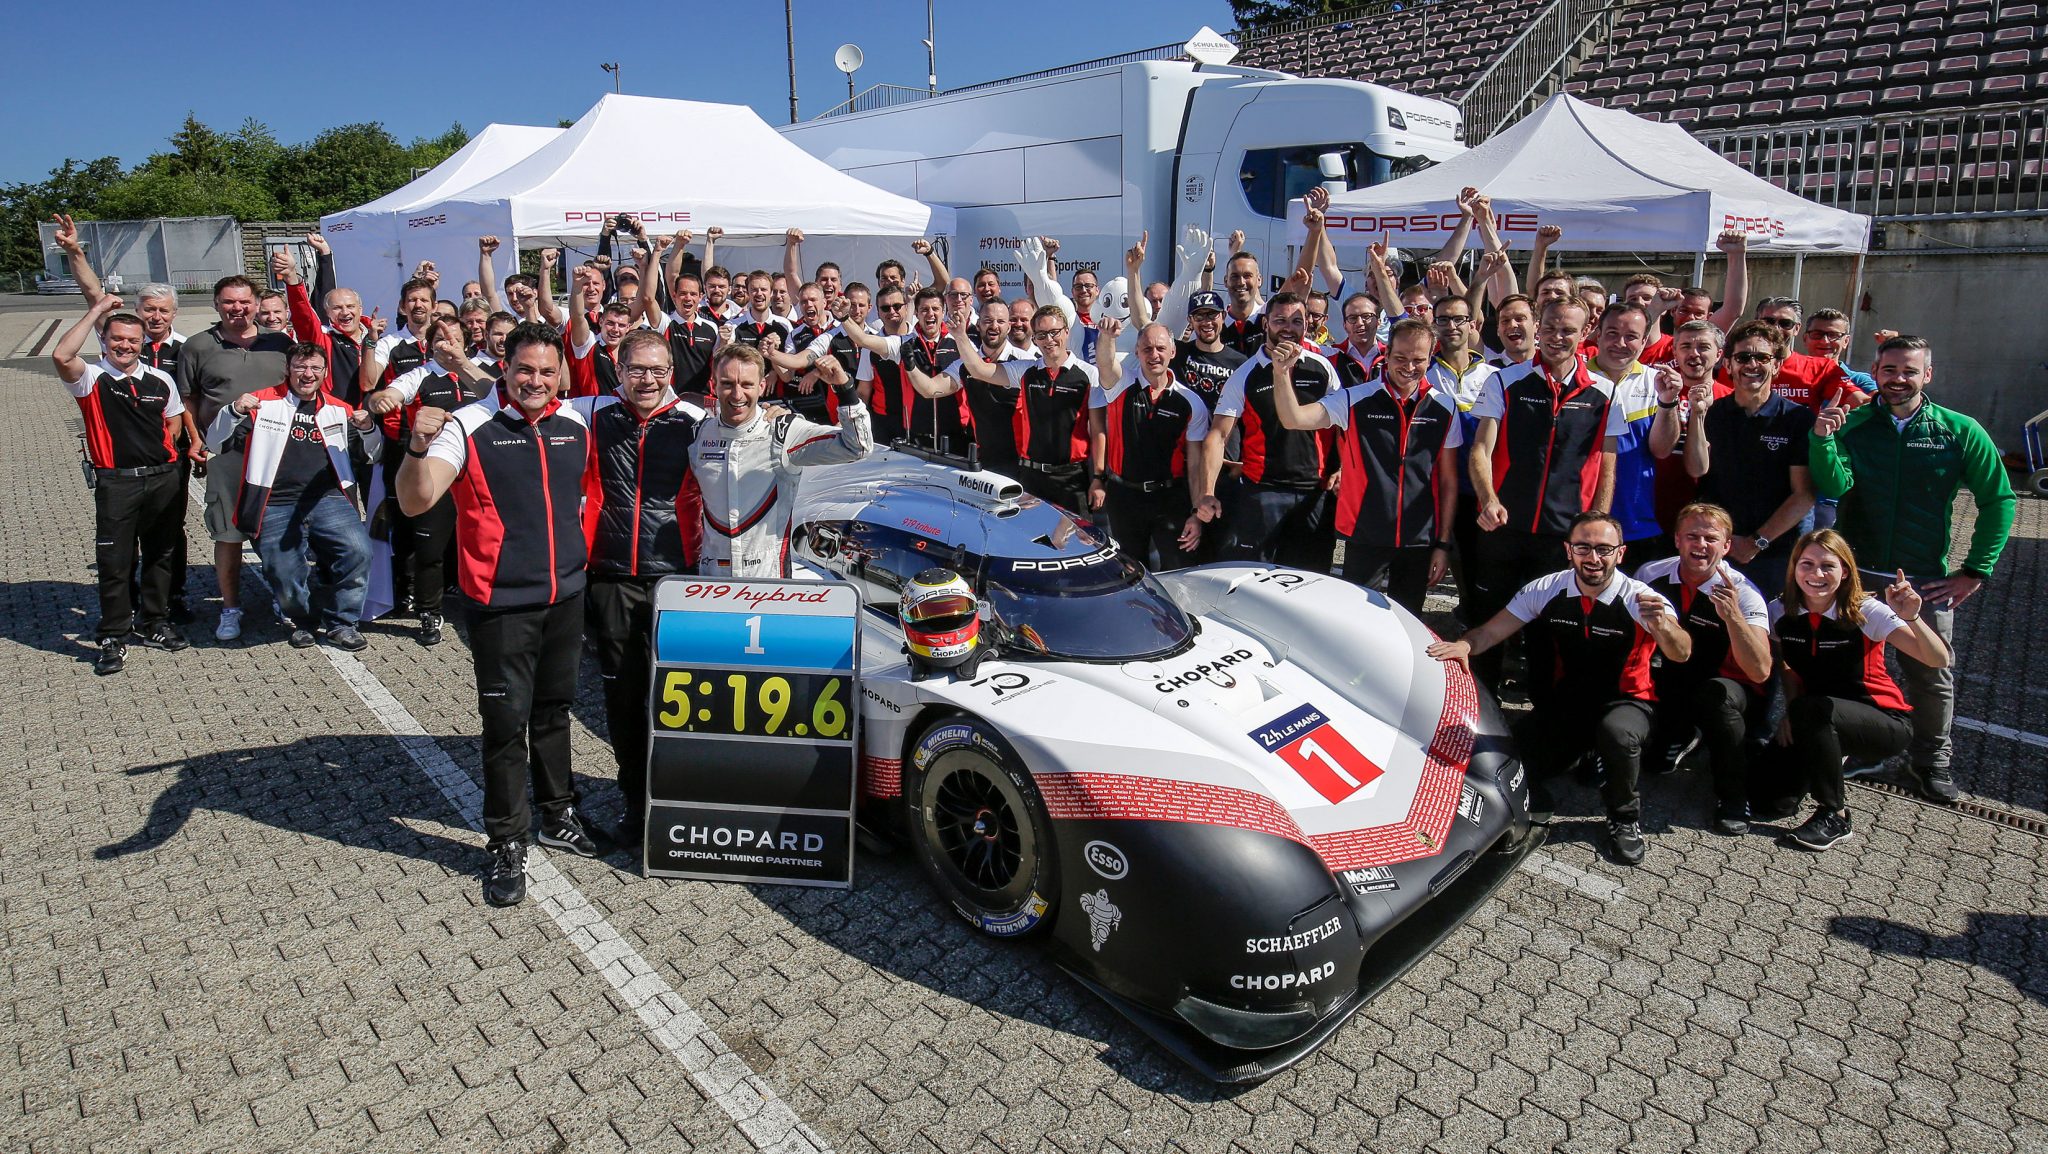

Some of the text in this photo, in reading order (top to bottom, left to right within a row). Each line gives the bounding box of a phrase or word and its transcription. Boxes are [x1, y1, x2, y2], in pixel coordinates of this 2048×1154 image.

[1406, 111, 1453, 129] PORSCHE
[327, 222, 353, 232] PORSCHE
[408, 214, 447, 229] PORSCHE
[1724, 214, 1785, 237] PORSCHE
[980, 260, 1017, 273] Mission:
[1193, 293, 1214, 306] YZ
[1772, 388, 1809, 398] RIBUTE
[702, 439, 719, 447] Mobil
[958, 474, 984, 492] Mobil
[902, 517, 942, 535] 919 tribute
[743, 558, 762, 567] Timo
[1012, 536, 1121, 572] PORSCHE
[685, 584, 831, 610] 919 hybrid
[744, 615, 765, 655] 1
[931, 646, 968, 658] CHOPARD
[1155, 649, 1253, 693] CHOPARD
[861, 685, 901, 714] HOPARD
[991, 679, 1057, 706] PORSCHE
[1260, 712, 1321, 747] 24h LE MANS
[928, 729, 969, 749] MICHELIN
[1298, 737, 1362, 789] 1
[669, 824, 824, 852] CHOPARD
[668, 850, 823, 868] OFFICIAL TIMING PARTNER
[1343, 867, 1382, 884] Mobil
[1366, 883, 1396, 891] MICHELIN
[985, 916, 1030, 934] MICHELIN
[1246, 916, 1342, 954] SCHAEFFLER
[1230, 960, 1336, 990] CHOPARD
